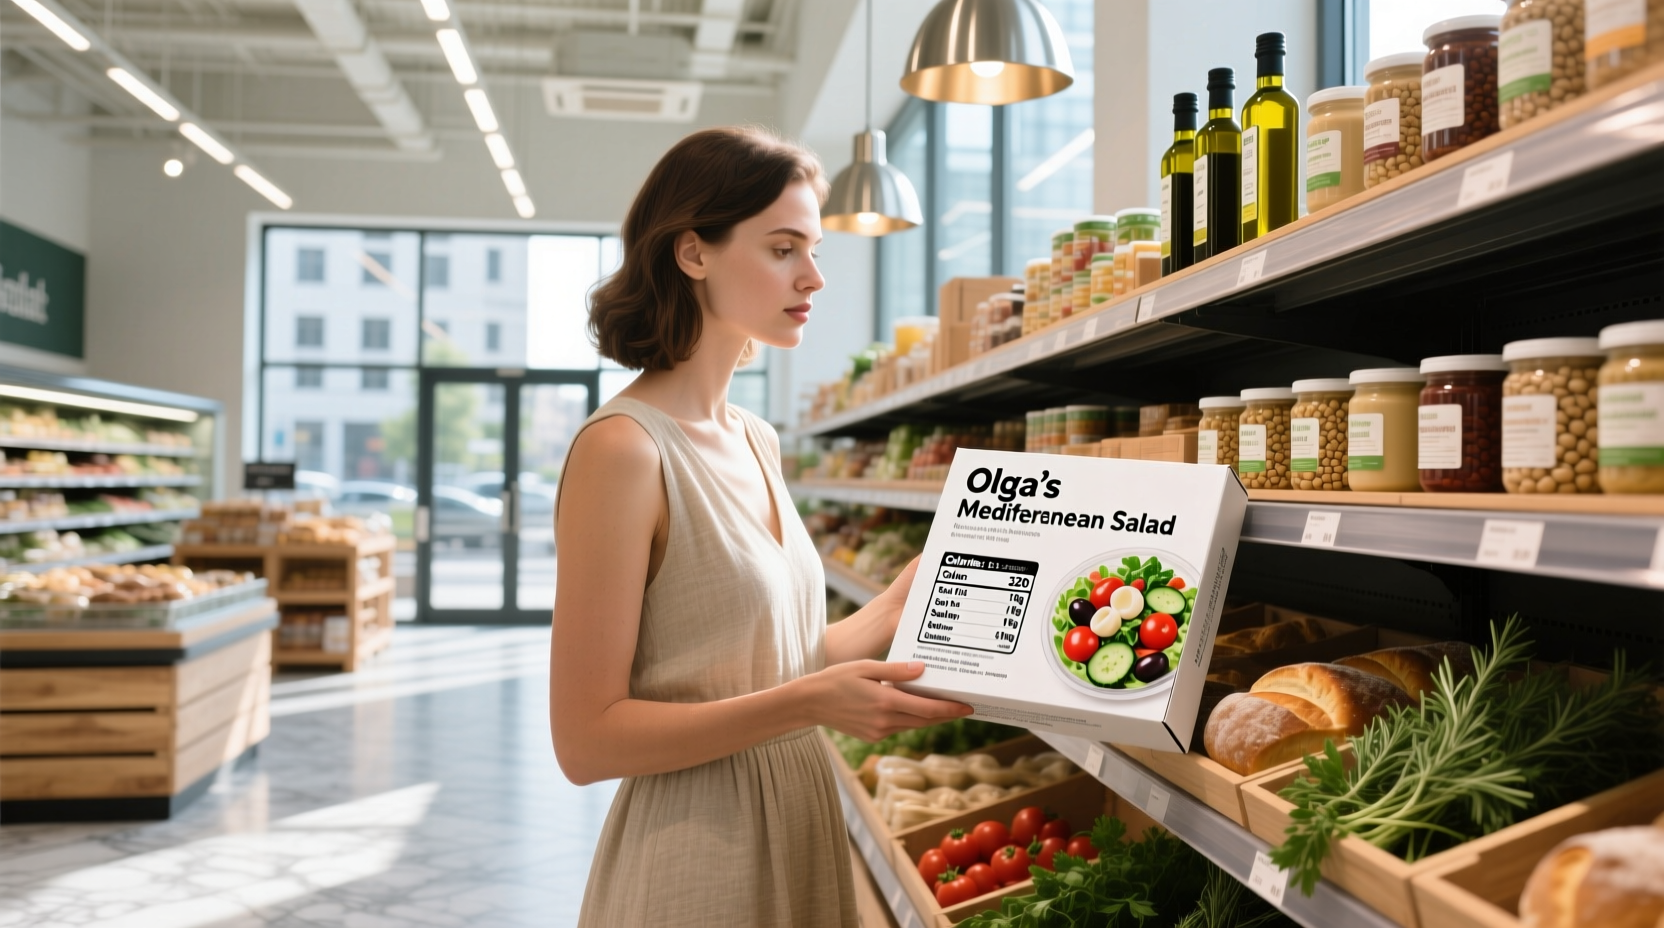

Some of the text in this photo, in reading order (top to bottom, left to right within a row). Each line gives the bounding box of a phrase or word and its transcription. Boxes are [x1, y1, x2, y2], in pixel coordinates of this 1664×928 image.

[966, 467, 1062, 502] Olga's
[1110, 510, 1177, 536] Salad
[1008, 576, 1030, 588] 320
